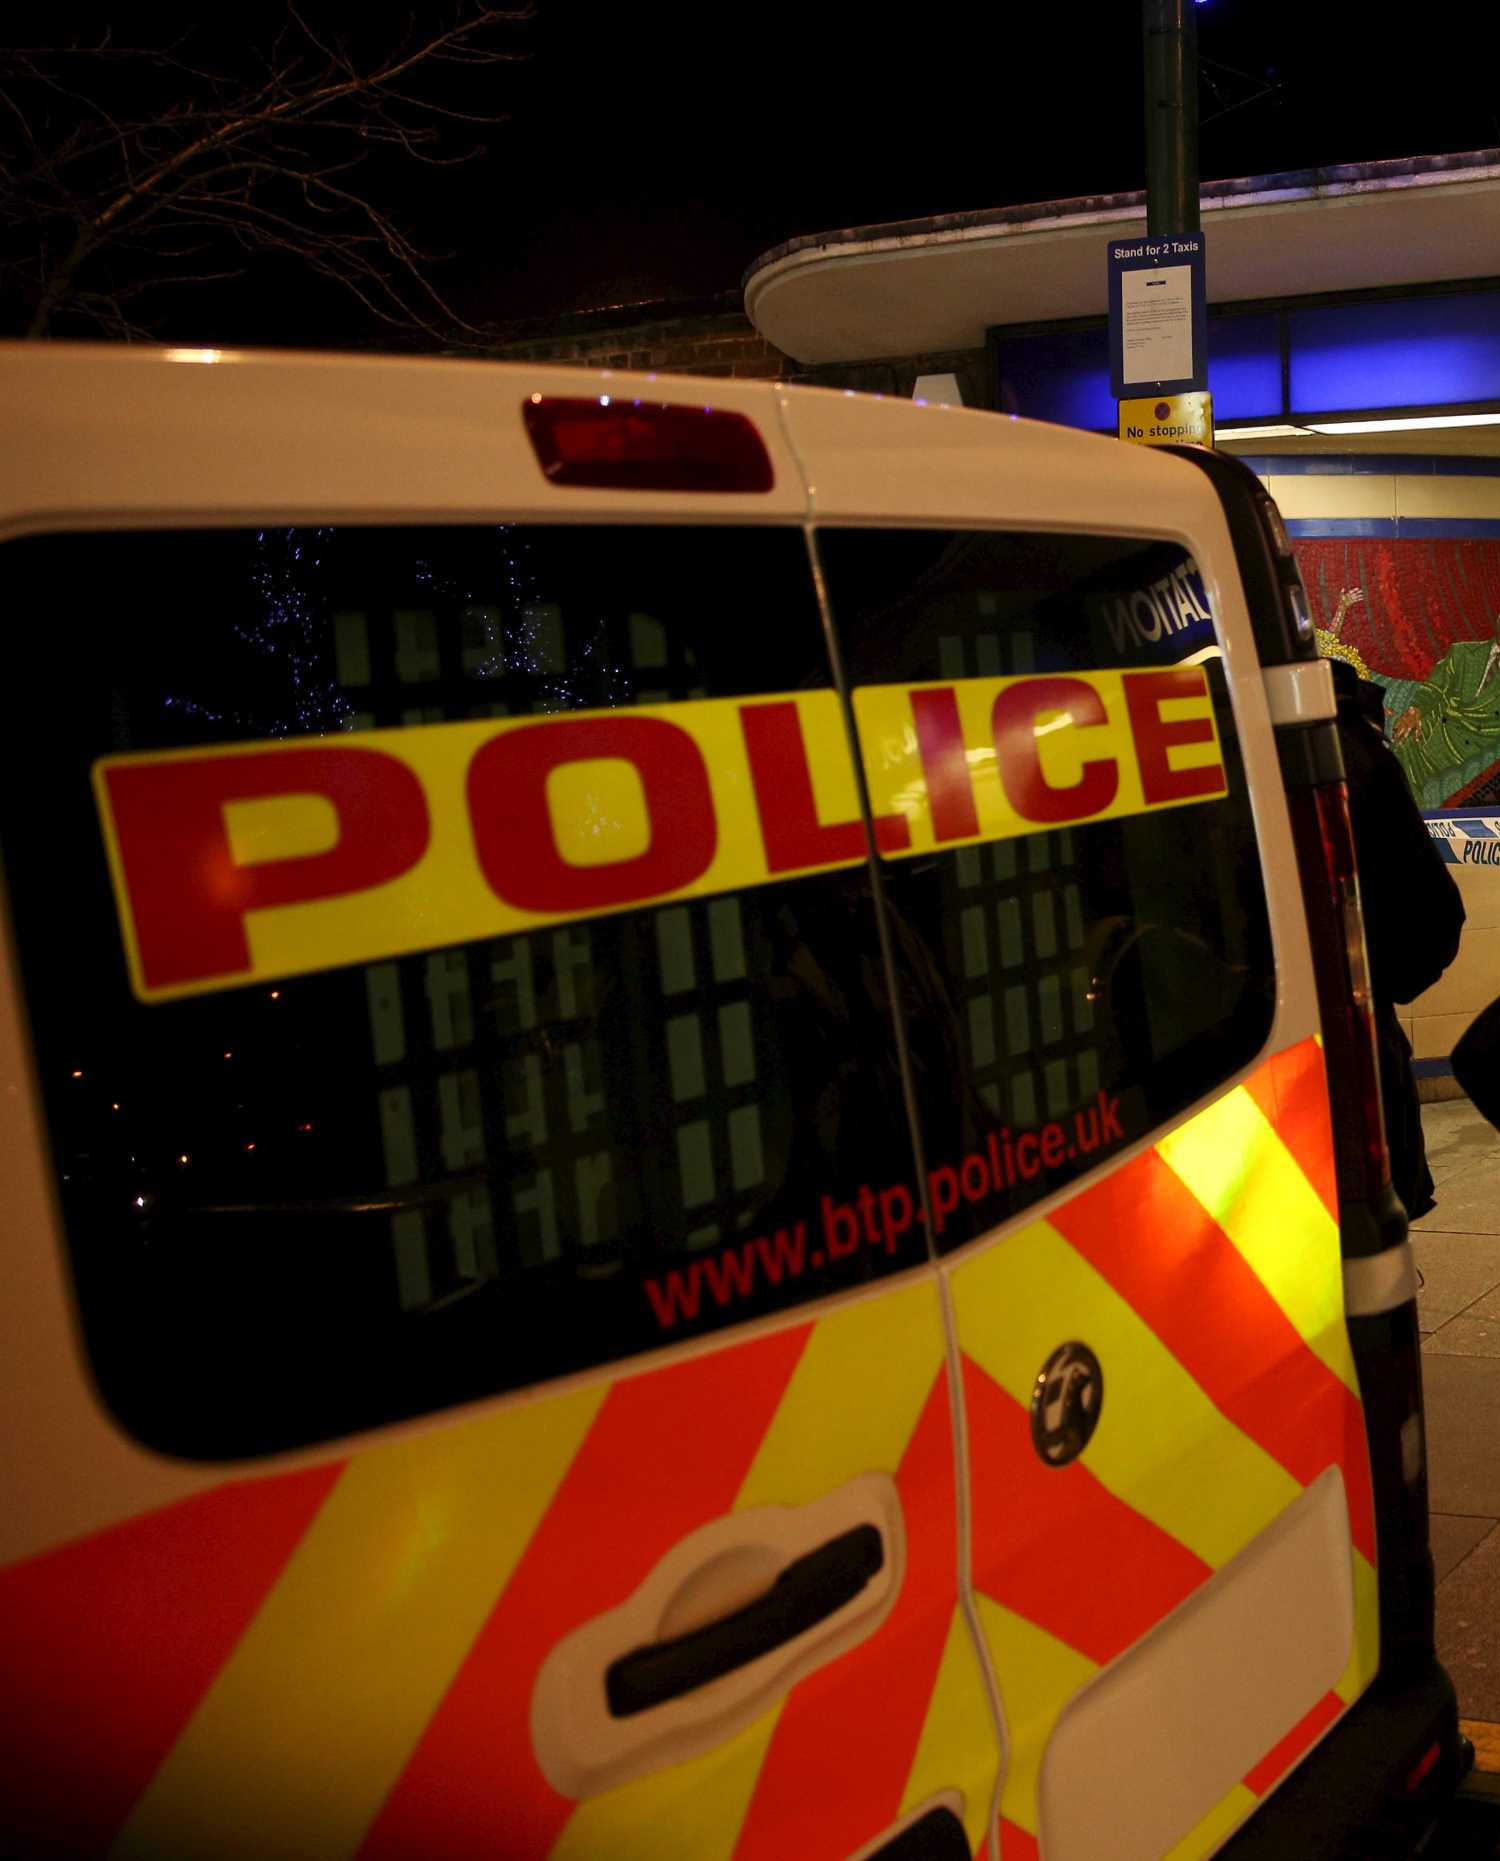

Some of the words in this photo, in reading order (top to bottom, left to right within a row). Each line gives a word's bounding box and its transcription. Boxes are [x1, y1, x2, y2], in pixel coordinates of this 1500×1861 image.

[1114, 246, 1143, 259] Stand
[1146, 245, 1160, 256] for
[1163, 243, 1169, 254] 2
[1172, 241, 1199, 253] Taxis
[1127, 426, 1144, 438] No
[1149, 421, 1204, 437] stopping
[104, 667, 1225, 992] POLICE
[644, 1090, 1125, 1330] www.btp.police.uk
